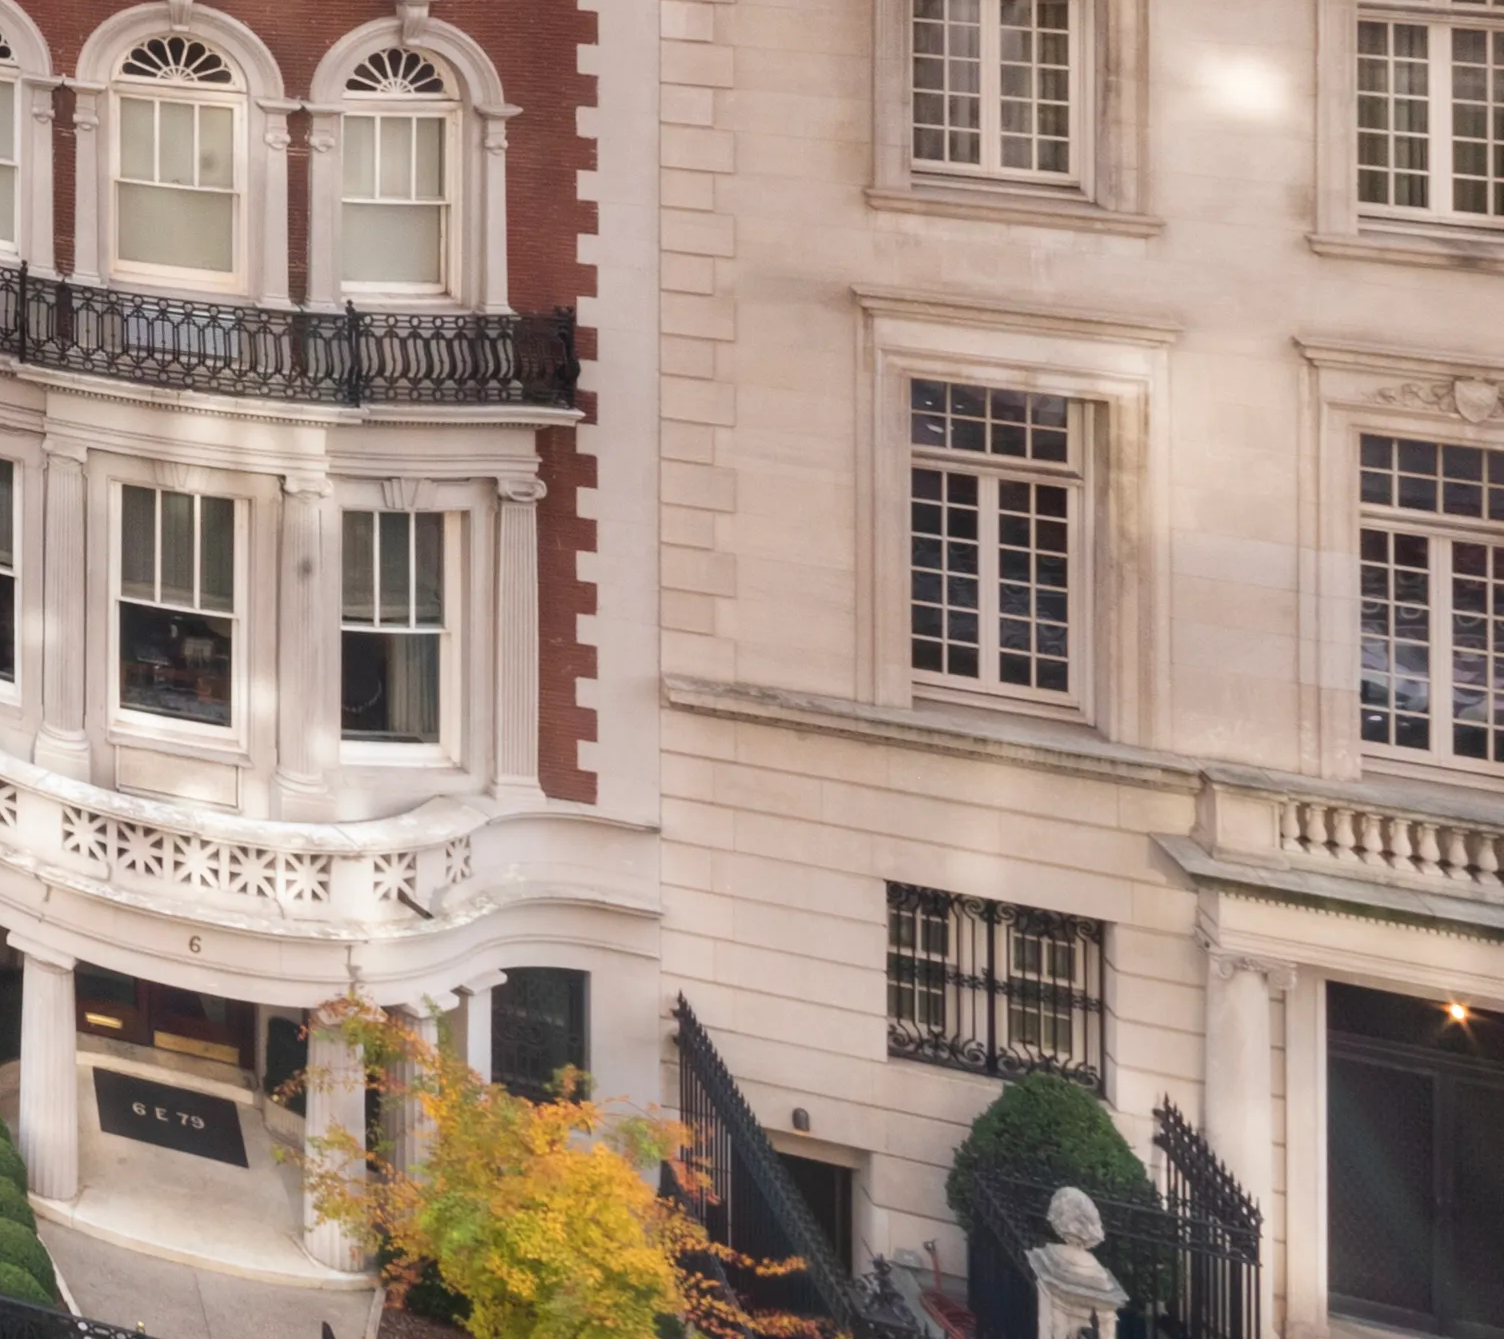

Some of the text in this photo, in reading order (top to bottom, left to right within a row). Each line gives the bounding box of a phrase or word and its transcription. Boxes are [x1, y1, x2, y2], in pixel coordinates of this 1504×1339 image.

[189, 935, 201, 953] 6
[132, 1102, 205, 1129] 6 E 79
